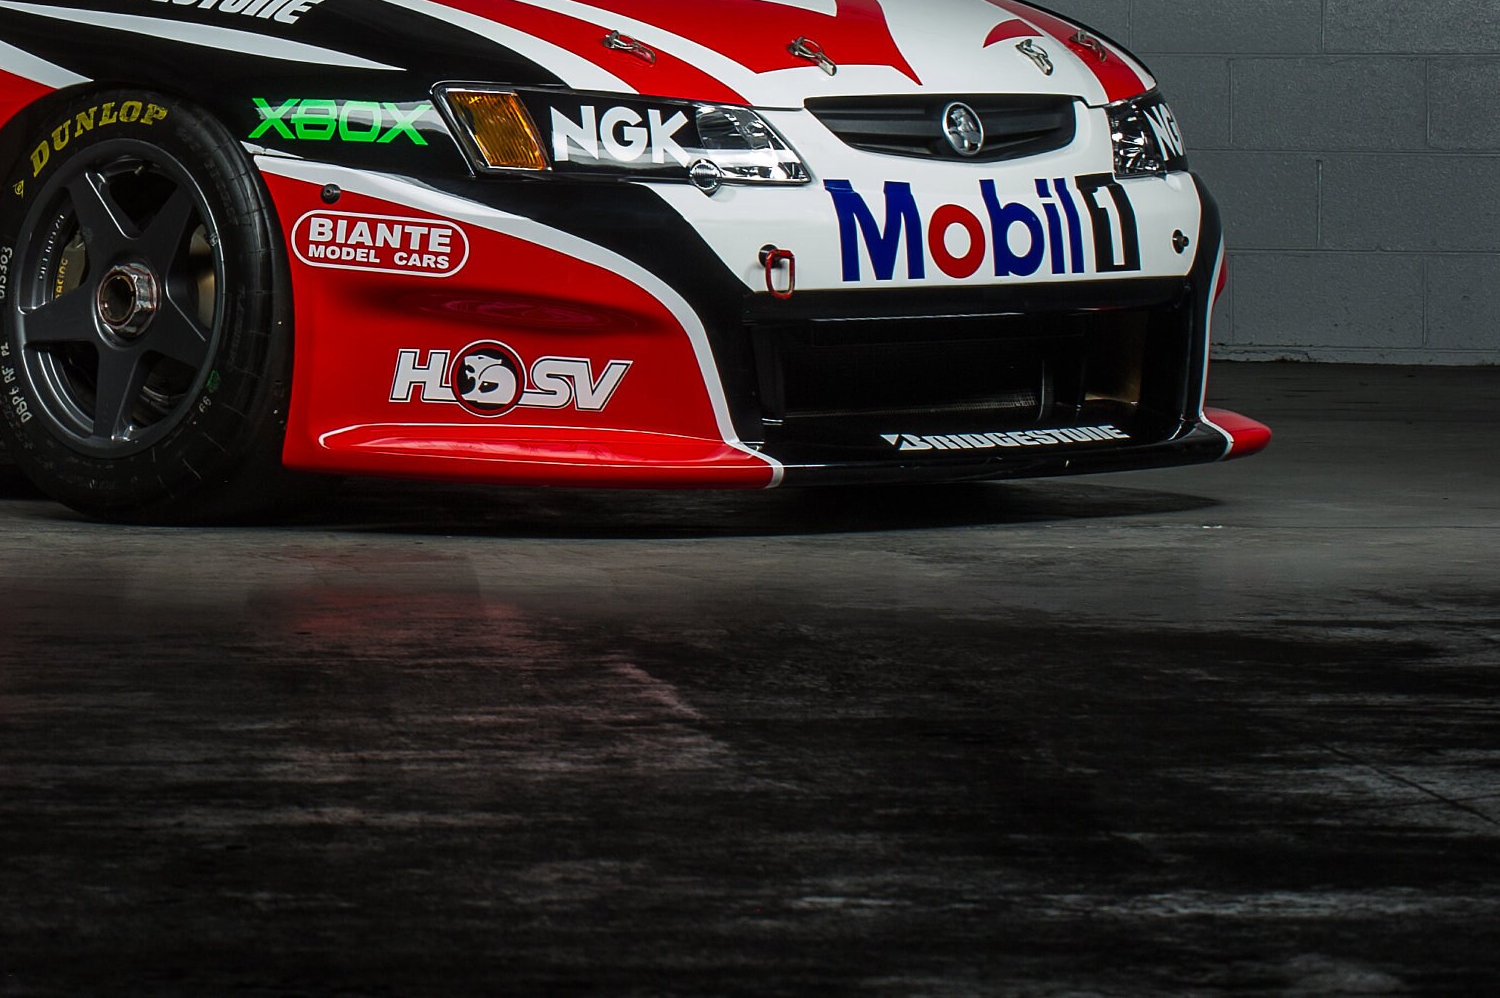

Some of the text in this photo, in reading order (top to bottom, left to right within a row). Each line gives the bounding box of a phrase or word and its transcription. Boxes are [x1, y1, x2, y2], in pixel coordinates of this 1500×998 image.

[30, 100, 169, 178] DUNLOP
[248, 97, 432, 146] XBOX
[550, 105, 691, 168] NGK
[1142, 102, 1188, 161] NG
[308, 218, 453, 255] BIANTE
[308, 244, 451, 269] MODEL CARS
[880, 423, 1132, 452] BRIDGESTONE
